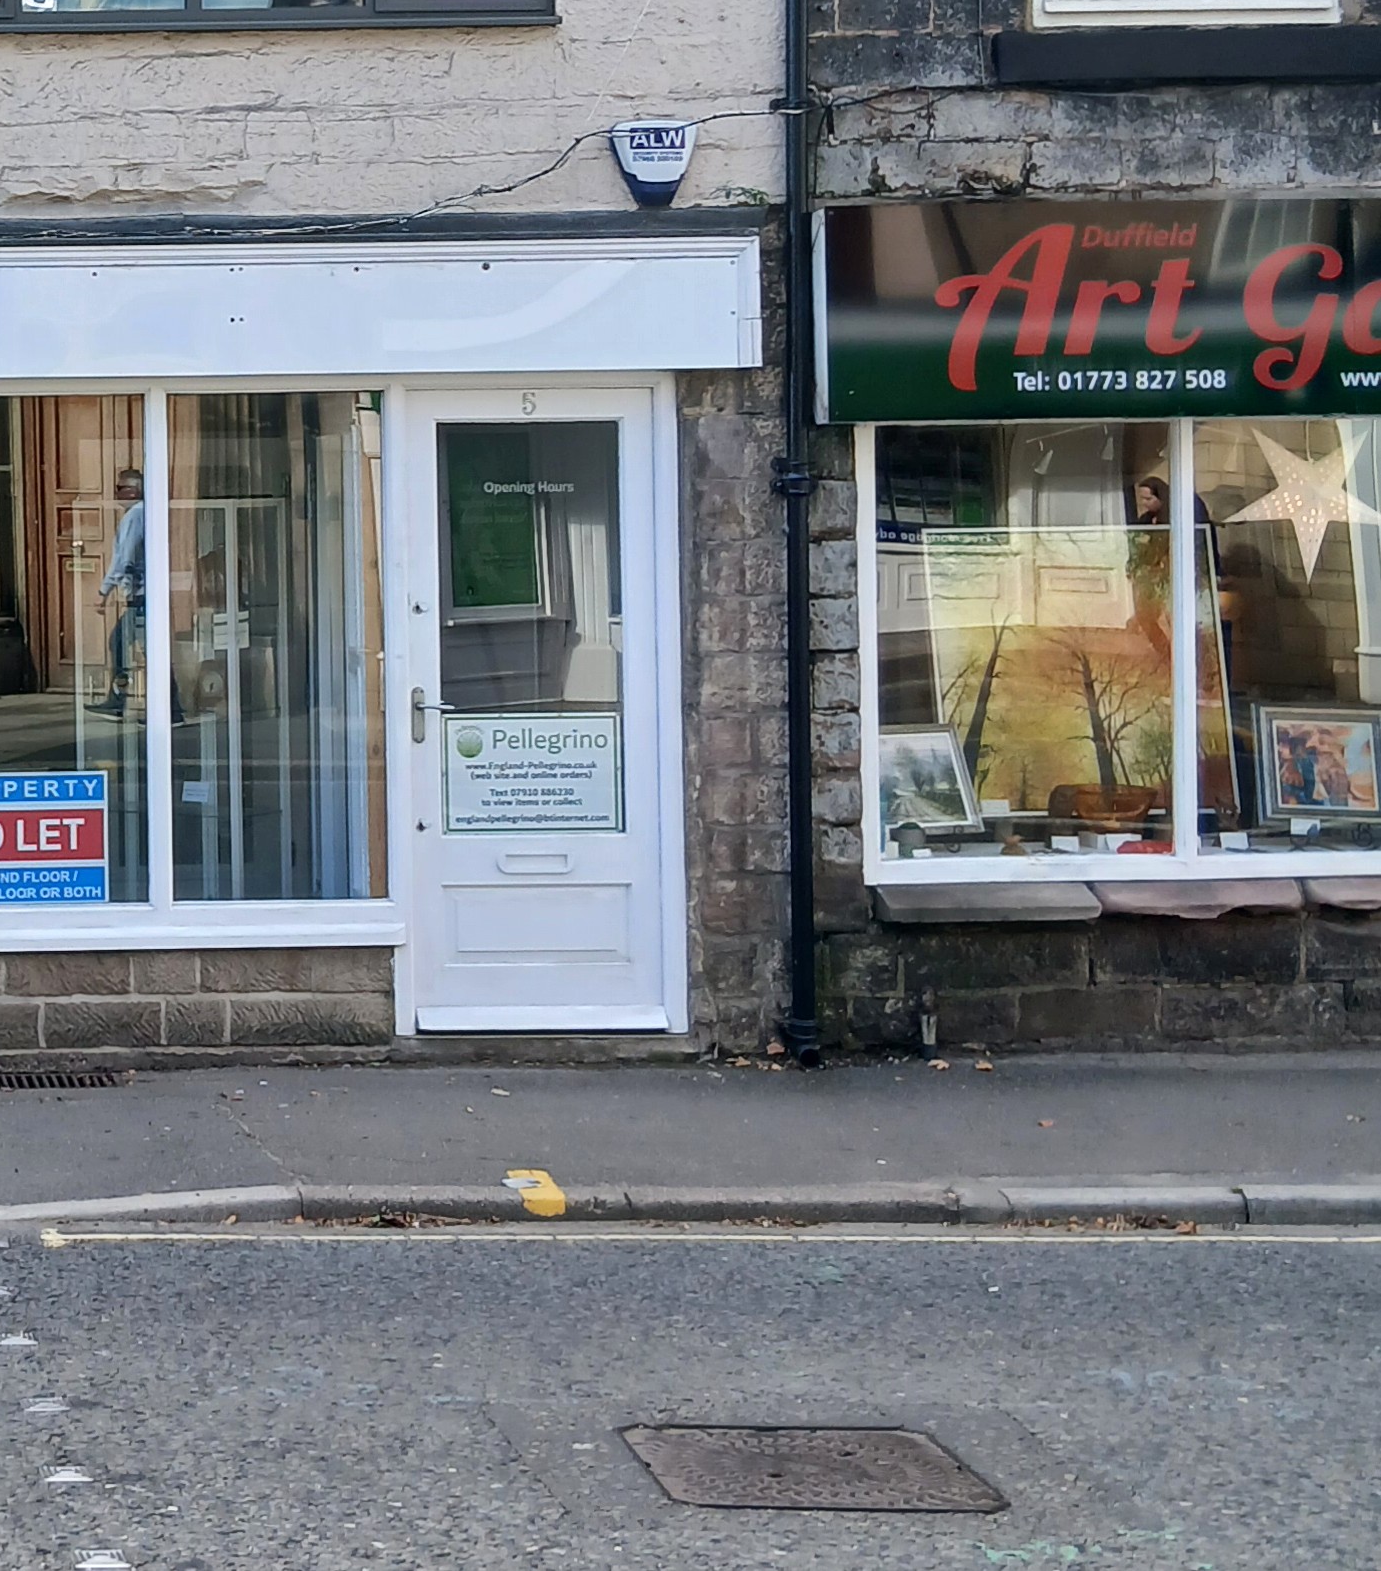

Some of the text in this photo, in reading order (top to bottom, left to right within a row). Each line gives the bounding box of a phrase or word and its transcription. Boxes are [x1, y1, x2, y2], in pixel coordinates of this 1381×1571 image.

[631, 129, 683, 148] ALW
[1080, 222, 1198, 249] Duffield
[934, 223, 1204, 391] Art
[1013, 370, 1050, 391] Tel:
[1058, 370, 1127, 391] 01773
[1135, 369, 1177, 390] 827
[1185, 368, 1227, 390] 508
[521, 391, 537, 416] 5
[483, 480, 575, 496] Opening Hours
[492, 728, 608, 755] Pellegrino
[530, 770, 558, 780] online
[560, 770, 593, 780] orders)
[481, 799, 491, 807] to
[515, 798, 539, 807] items
[541, 799, 551, 807] or
[552, 797, 583, 806] collect
[489, 788, 509, 797] Text
[16, 818, 86, 851] LET
[23, 870, 70, 883] FLOOR
[40, 887, 61, 899] OR
[64, 886, 102, 898] BOTH
